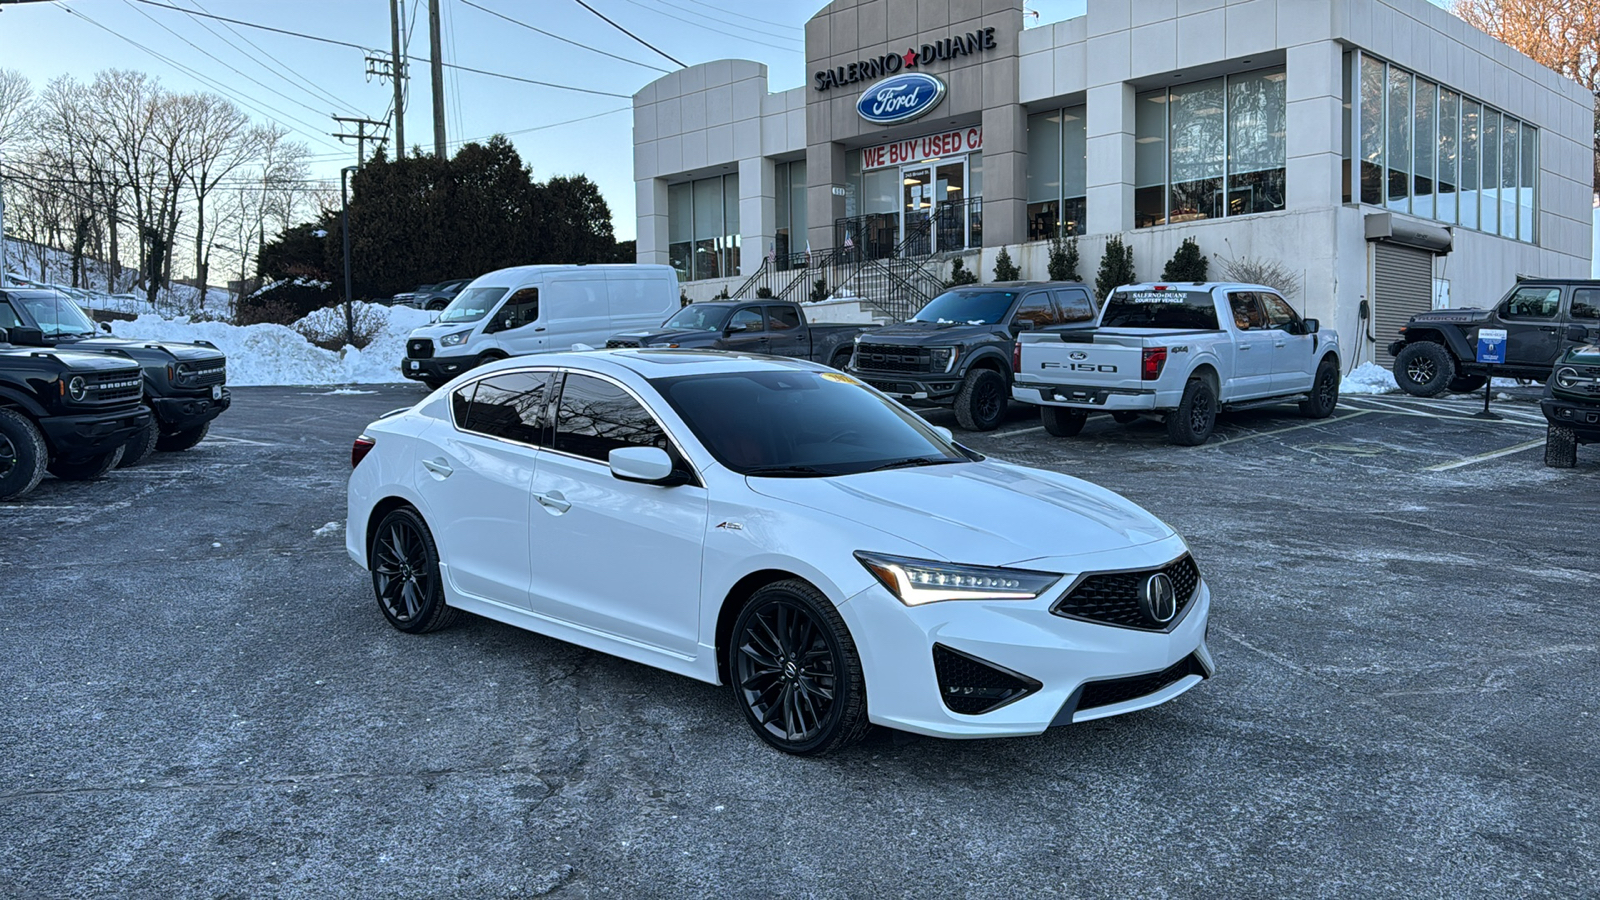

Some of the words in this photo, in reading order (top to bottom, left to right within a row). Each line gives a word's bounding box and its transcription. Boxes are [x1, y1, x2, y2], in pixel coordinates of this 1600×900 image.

[814, 52, 903, 91] SALERNO
[920, 27, 997, 65] DUANE
[872, 84, 920, 115] Ford
[864, 146, 885, 168] WE
[889, 140, 918, 165] BUY
[922, 132, 962, 156] USED
[857, 352, 919, 364] FORD
[1041, 362, 1117, 373] F-150
[100, 380, 138, 389] BRONCO
